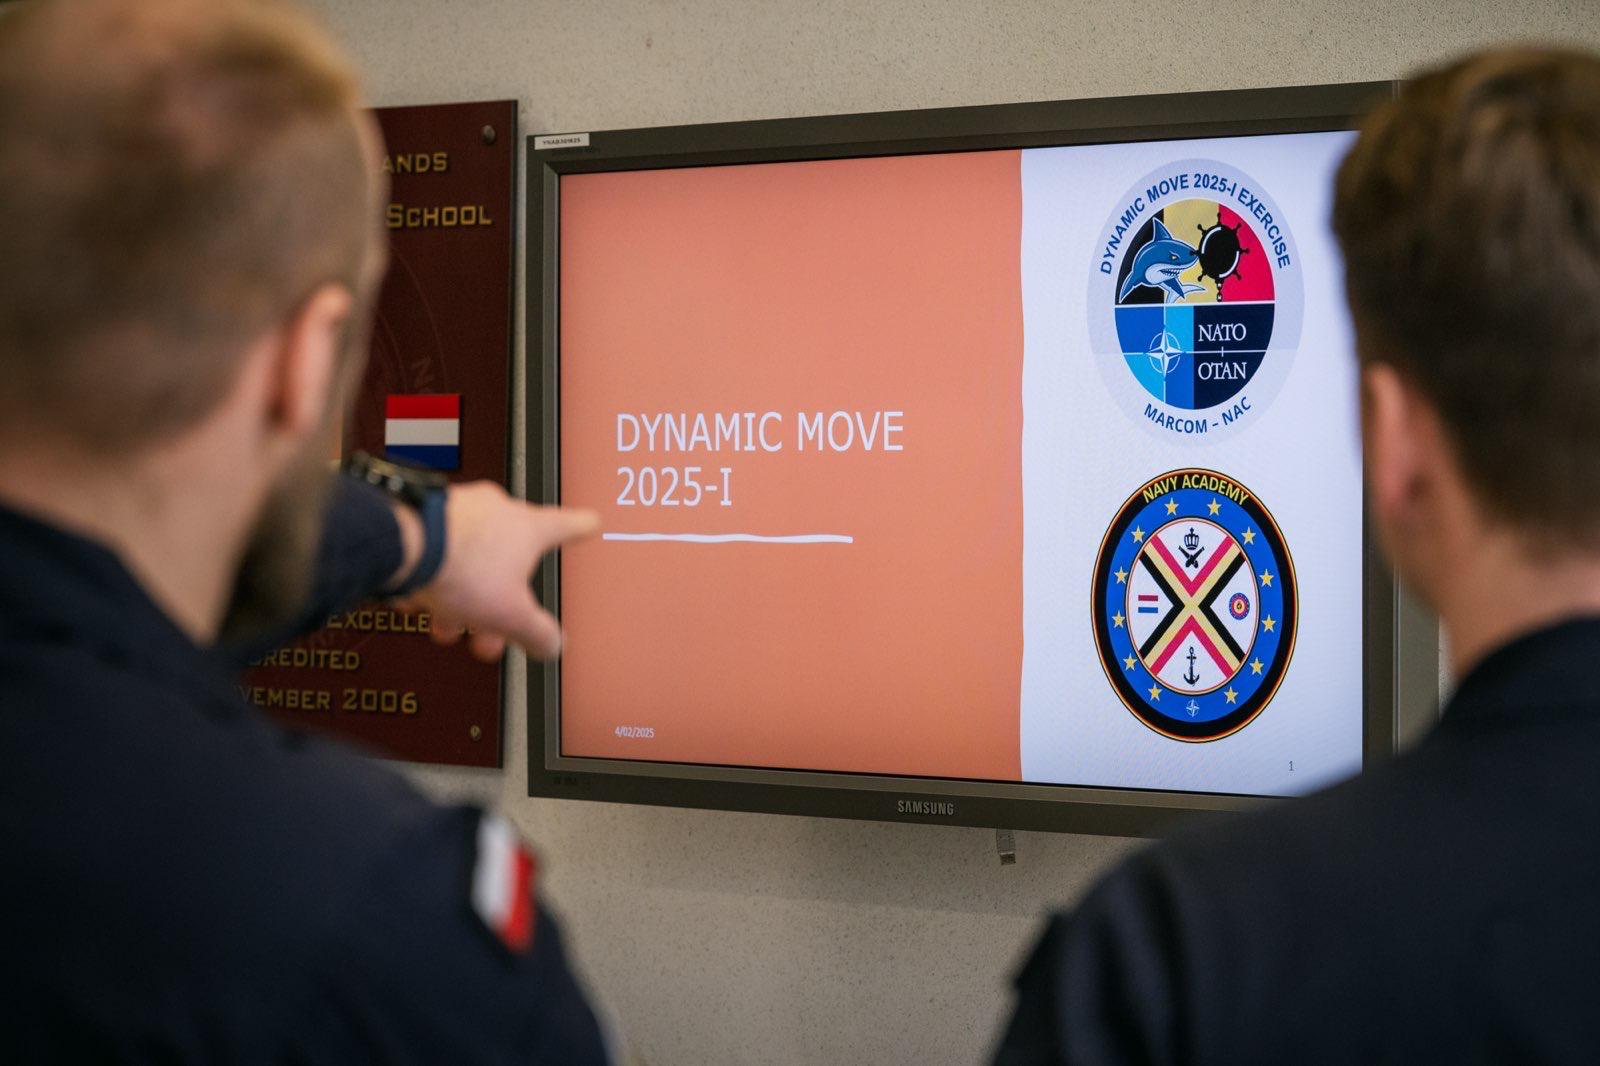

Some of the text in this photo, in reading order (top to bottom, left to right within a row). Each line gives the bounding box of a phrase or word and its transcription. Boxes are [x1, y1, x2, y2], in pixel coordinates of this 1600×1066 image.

[381, 152, 448, 173] ANDS
[386, 202, 493, 229] SCHOOL
[1100, 172, 1291, 275] DYNAMIC MOVE 2025-I EXERCISE
[1198, 323, 1247, 342] NATO
[1197, 361, 1248, 381] OTAN
[1144, 403, 1208, 434] MARCOM
[1221, 396, 1252, 426] NAC
[616, 411, 904, 452] DYNAMIC MOVE
[616, 466, 732, 506] 2025-I
[1142, 473, 1249, 506] NAVY ACADEMY
[327, 610, 474, 634] EXCELLE
[236, 686, 418, 714] VEMBER 2006
[614, 726, 655, 739] 4/02/2025
[1288, 760, 1295, 771] 1
[897, 799, 955, 816] SAMSUNG
